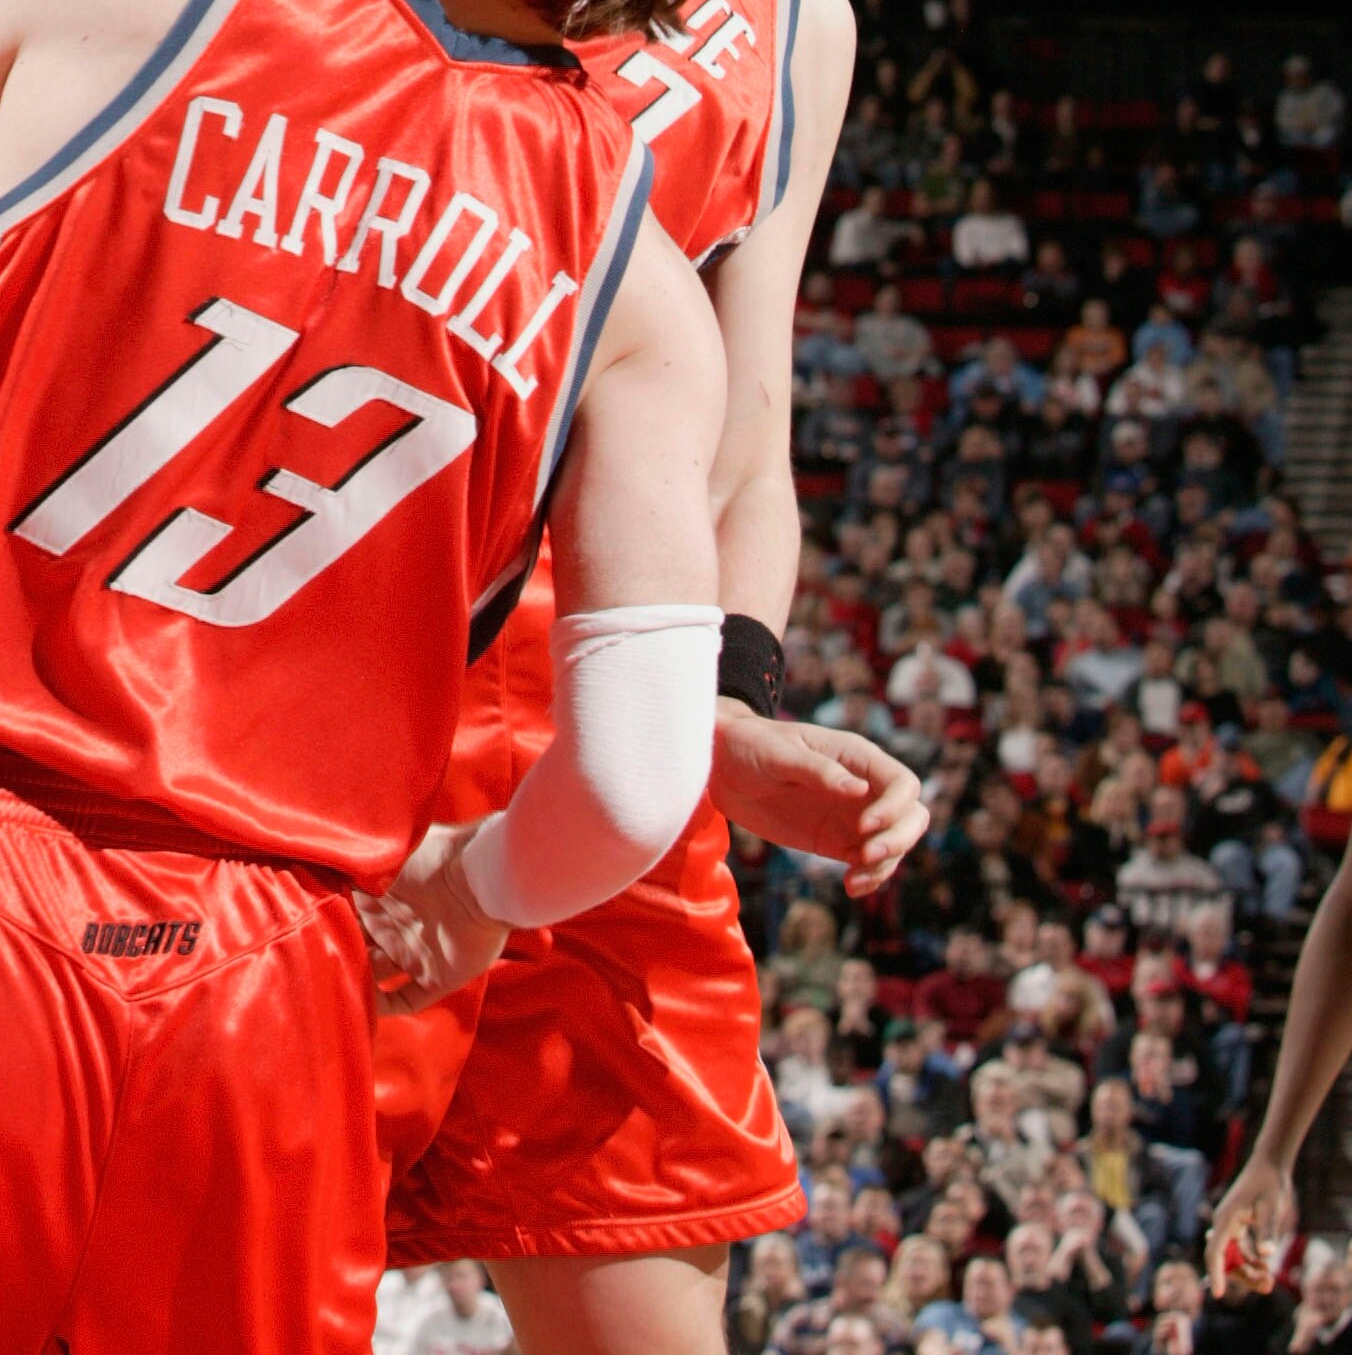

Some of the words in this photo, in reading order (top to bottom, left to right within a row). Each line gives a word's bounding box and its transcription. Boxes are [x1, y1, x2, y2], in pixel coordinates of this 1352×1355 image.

[163, 95, 580, 402] CARROLL
[8, 296, 477, 628] 13
[82, 921, 201, 958] BOBCATS
